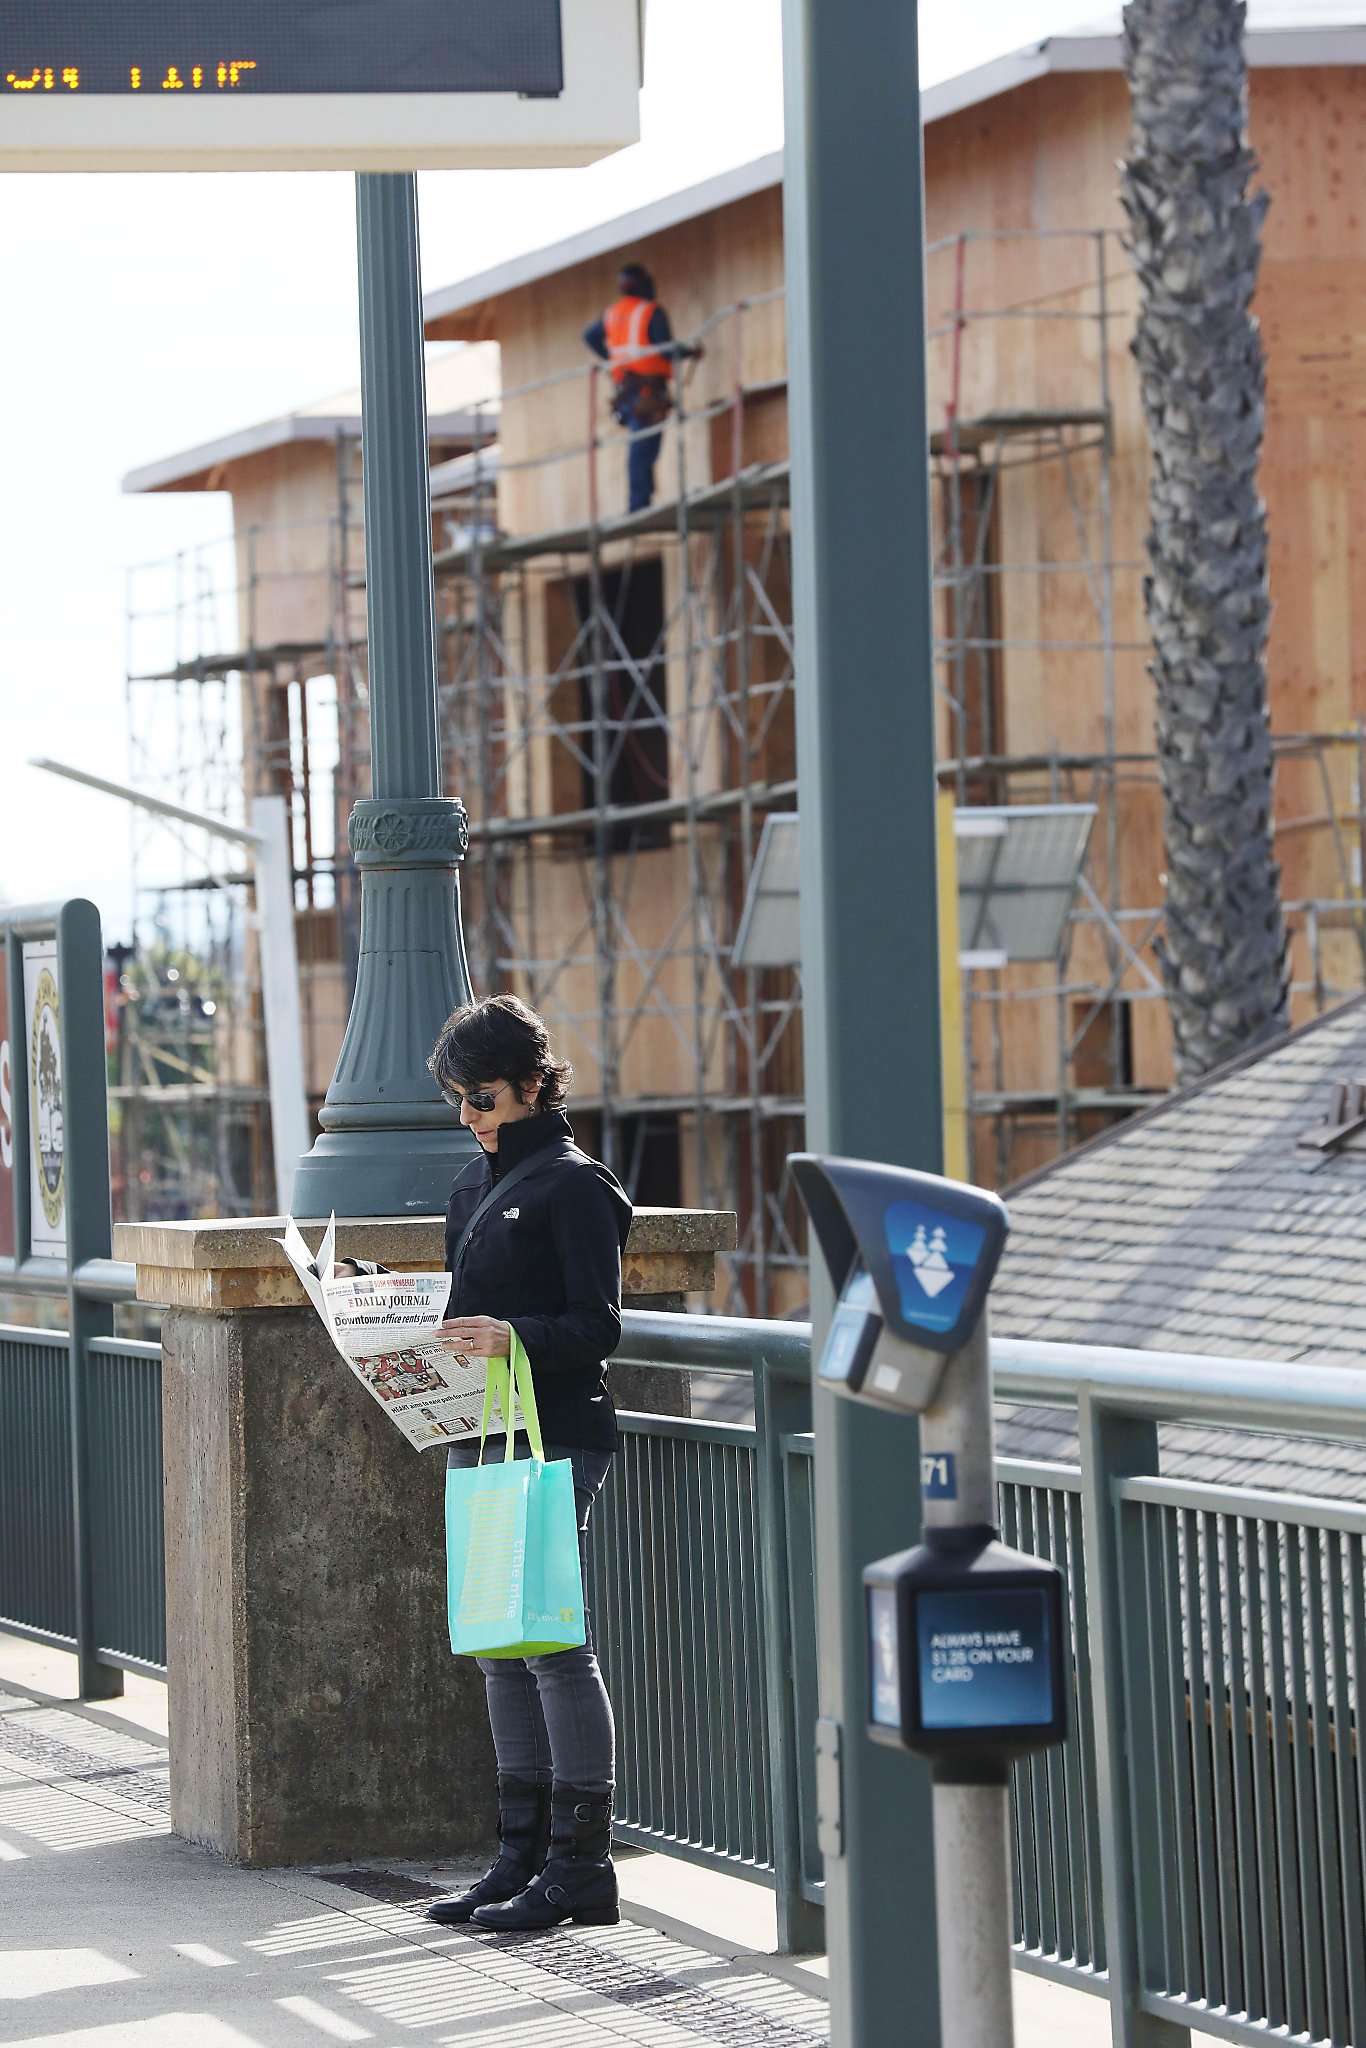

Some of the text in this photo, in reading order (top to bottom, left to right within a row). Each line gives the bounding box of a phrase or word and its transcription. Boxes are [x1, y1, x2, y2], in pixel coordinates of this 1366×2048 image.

[354, 1295, 431, 1309] DAILY JOURNAL
[334, 1313, 439, 1326] Downtown office rents jump
[391, 1404, 410, 1413] HEART
[410, 1401, 421, 1409] aims
[441, 1396, 453, 1404] path
[508, 1584, 519, 1619] nine
[931, 1630, 1022, 1649] ALWAYS HAVE
[968, 1649, 993, 1665] ON
[995, 1647, 1034, 1664] YOUR
[931, 1666, 974, 1683] CARD
